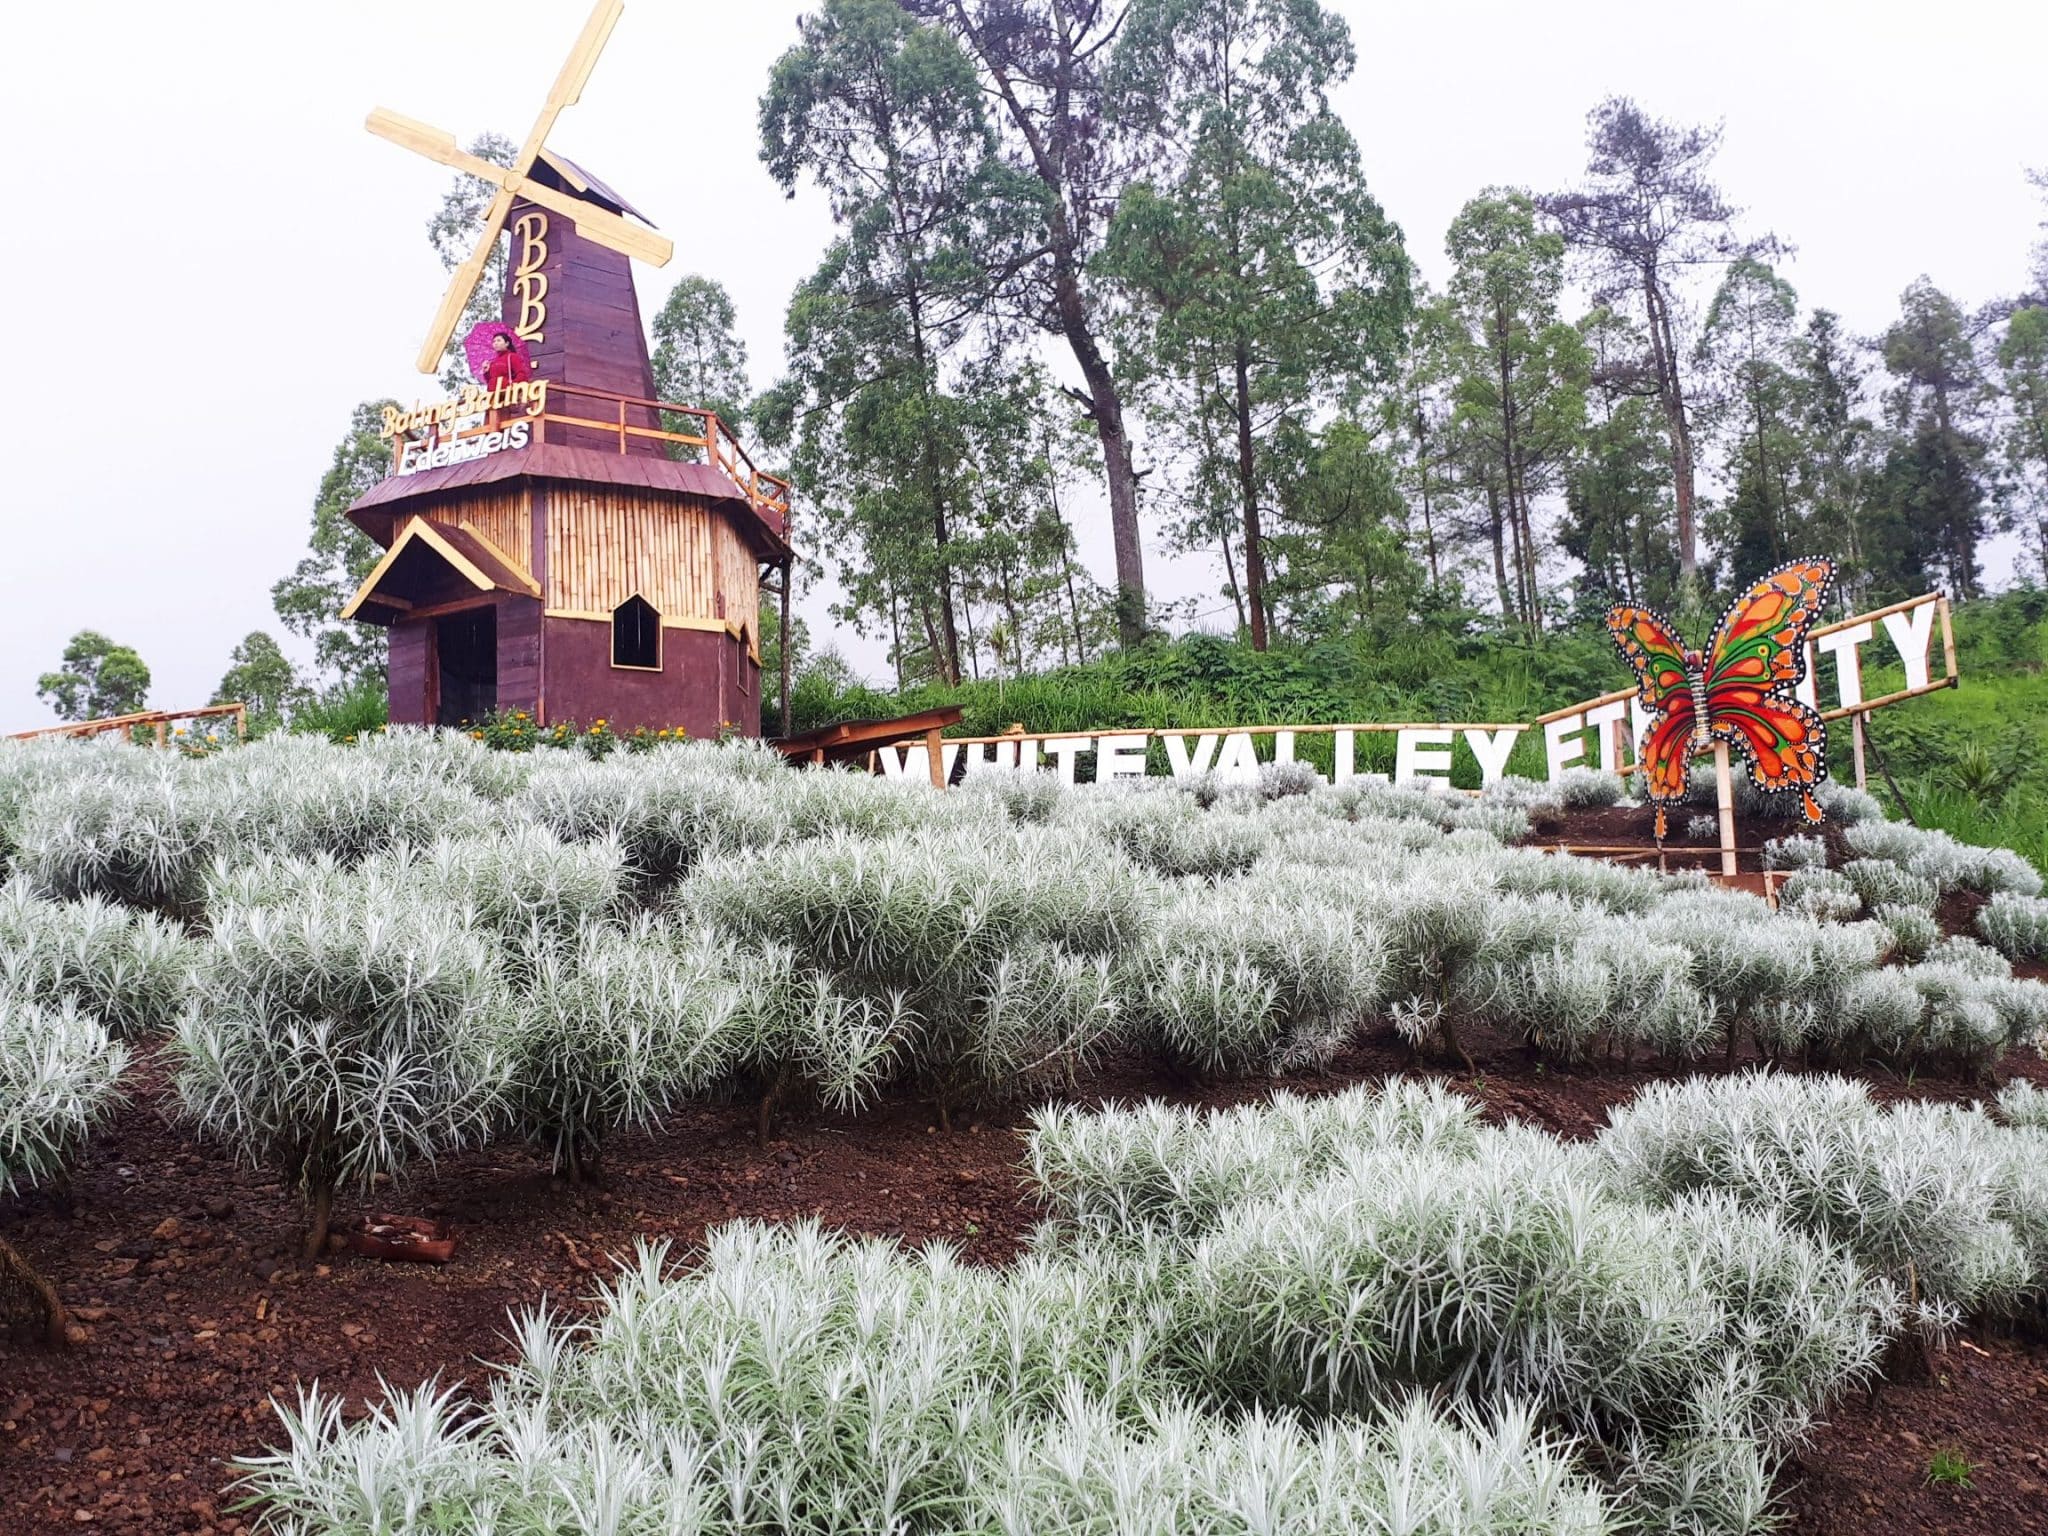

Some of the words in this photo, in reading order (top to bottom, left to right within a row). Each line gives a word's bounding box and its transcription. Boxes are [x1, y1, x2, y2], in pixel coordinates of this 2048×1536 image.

[398, 420, 530, 476] Edelweis
[878, 735, 1147, 787] WHITE
[1163, 729, 1518, 791] VALLEY
